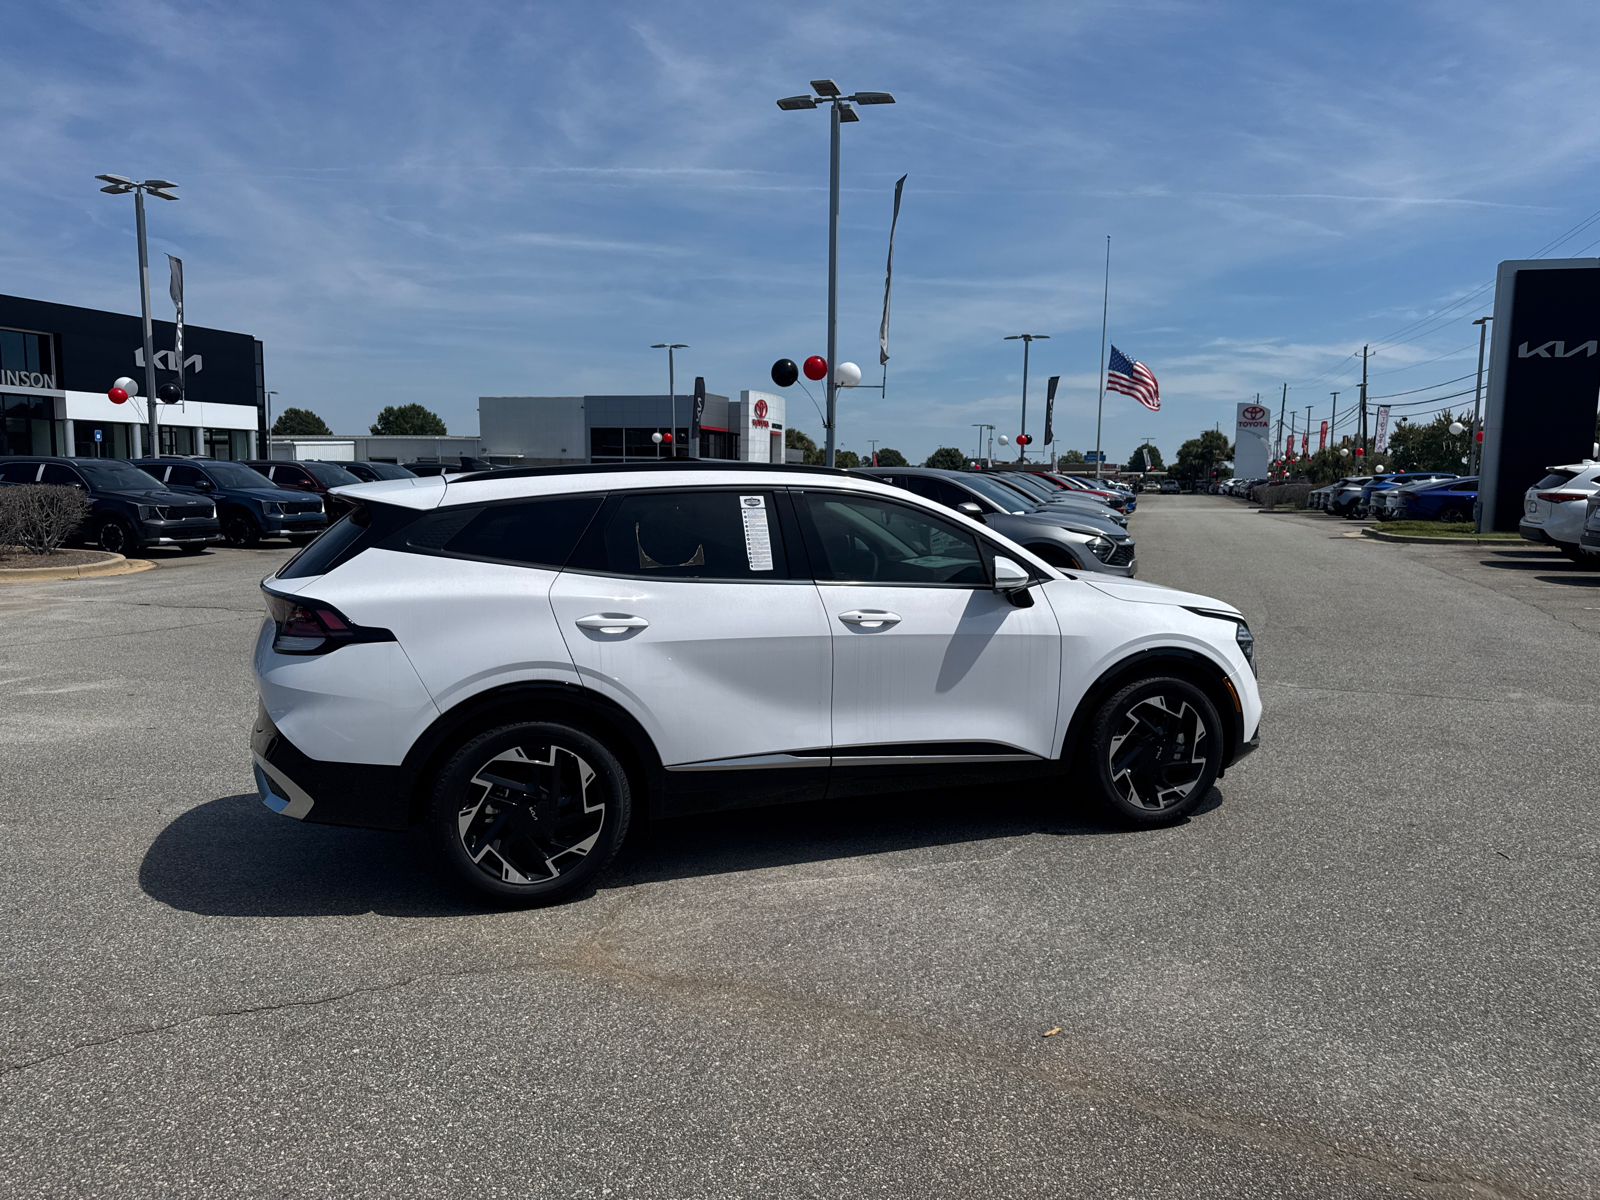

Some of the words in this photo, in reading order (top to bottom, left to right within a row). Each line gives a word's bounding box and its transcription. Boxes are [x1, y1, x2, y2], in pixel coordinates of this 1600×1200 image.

[1517, 340, 1598, 359] KIA
[134, 346, 203, 374] KIA
[1, 369, 55, 389] INSON
